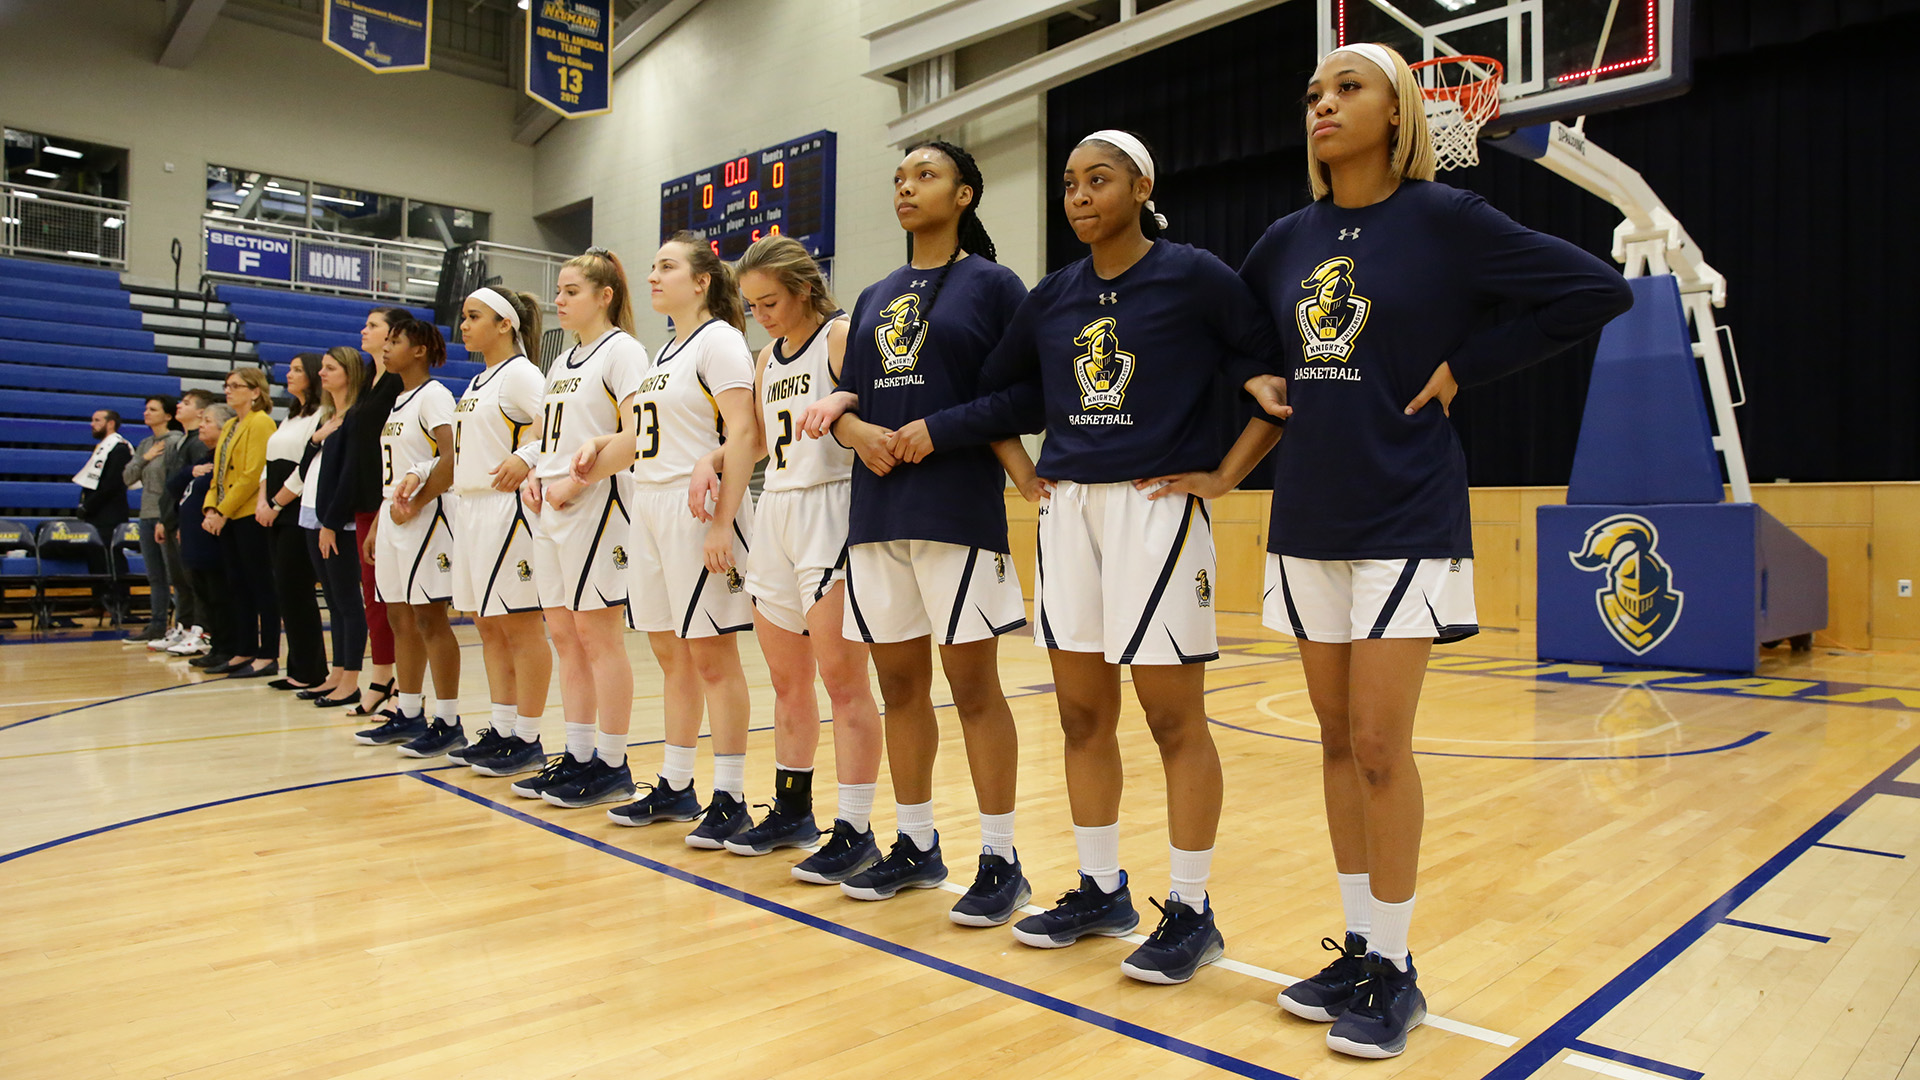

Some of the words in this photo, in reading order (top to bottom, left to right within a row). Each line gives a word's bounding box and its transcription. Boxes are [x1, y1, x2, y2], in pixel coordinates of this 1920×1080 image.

[544, 4, 598, 29] NEUMANN
[561, 42, 581, 56] TEAM
[557, 66, 583, 94] 13
[560, 91, 579, 105] 2012
[762, 149, 783, 165] Guests
[695, 172, 711, 186] Home
[773, 162, 784, 189] 0
[703, 184, 713, 210] 0
[727, 198, 745, 215] period
[749, 190, 758, 210] 0
[210, 232, 288, 254] SECTION
[238, 251, 261, 272] F
[309, 251, 362, 282] HOME
[1300, 309, 1314, 340] NEUMANN
[1341, 305, 1363, 341] UNIVERSITY
[1310, 343, 1345, 353] KNIGHTS
[1294, 367, 1361, 381] BASKETBALL
[766, 373, 811, 405] KNIGHTS
[1087, 394, 1118, 403] KNIGHTS
[540, 401, 564, 454] 14
[632, 401, 660, 460] 23
[1069, 413, 1133, 425] BASKETBALL
[775, 409, 793, 471] 2
[384, 444, 394, 487] 3
